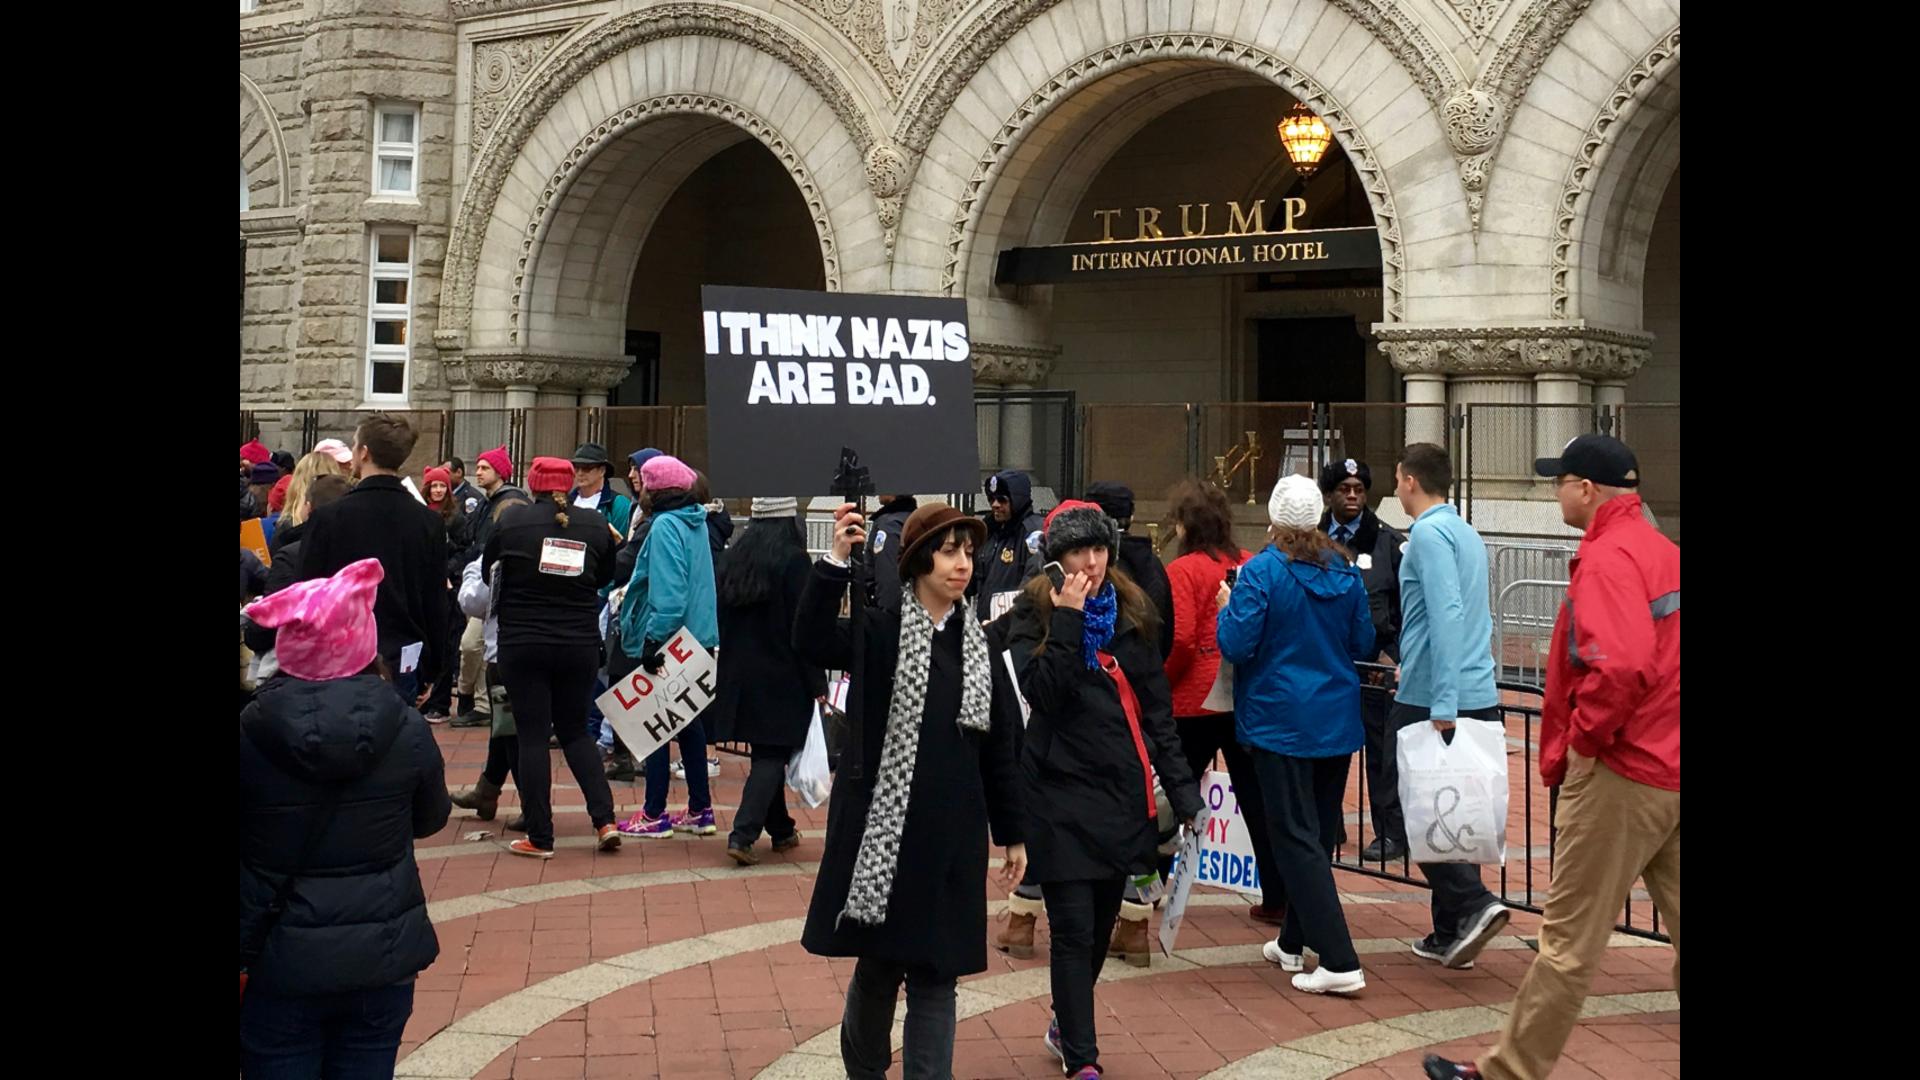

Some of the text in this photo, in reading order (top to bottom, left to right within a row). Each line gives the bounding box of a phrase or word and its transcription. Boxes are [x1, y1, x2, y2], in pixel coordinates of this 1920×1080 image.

[1093, 197, 1307, 242] TRUMP
[1071, 242, 1329, 271] INTERNATIONAL HOTEL
[703, 311, 970, 362] I THINK NAZIS
[747, 360, 937, 406] ARE BAD.
[643, 670, 717, 742] HATE
[654, 668, 689, 708] NOT
